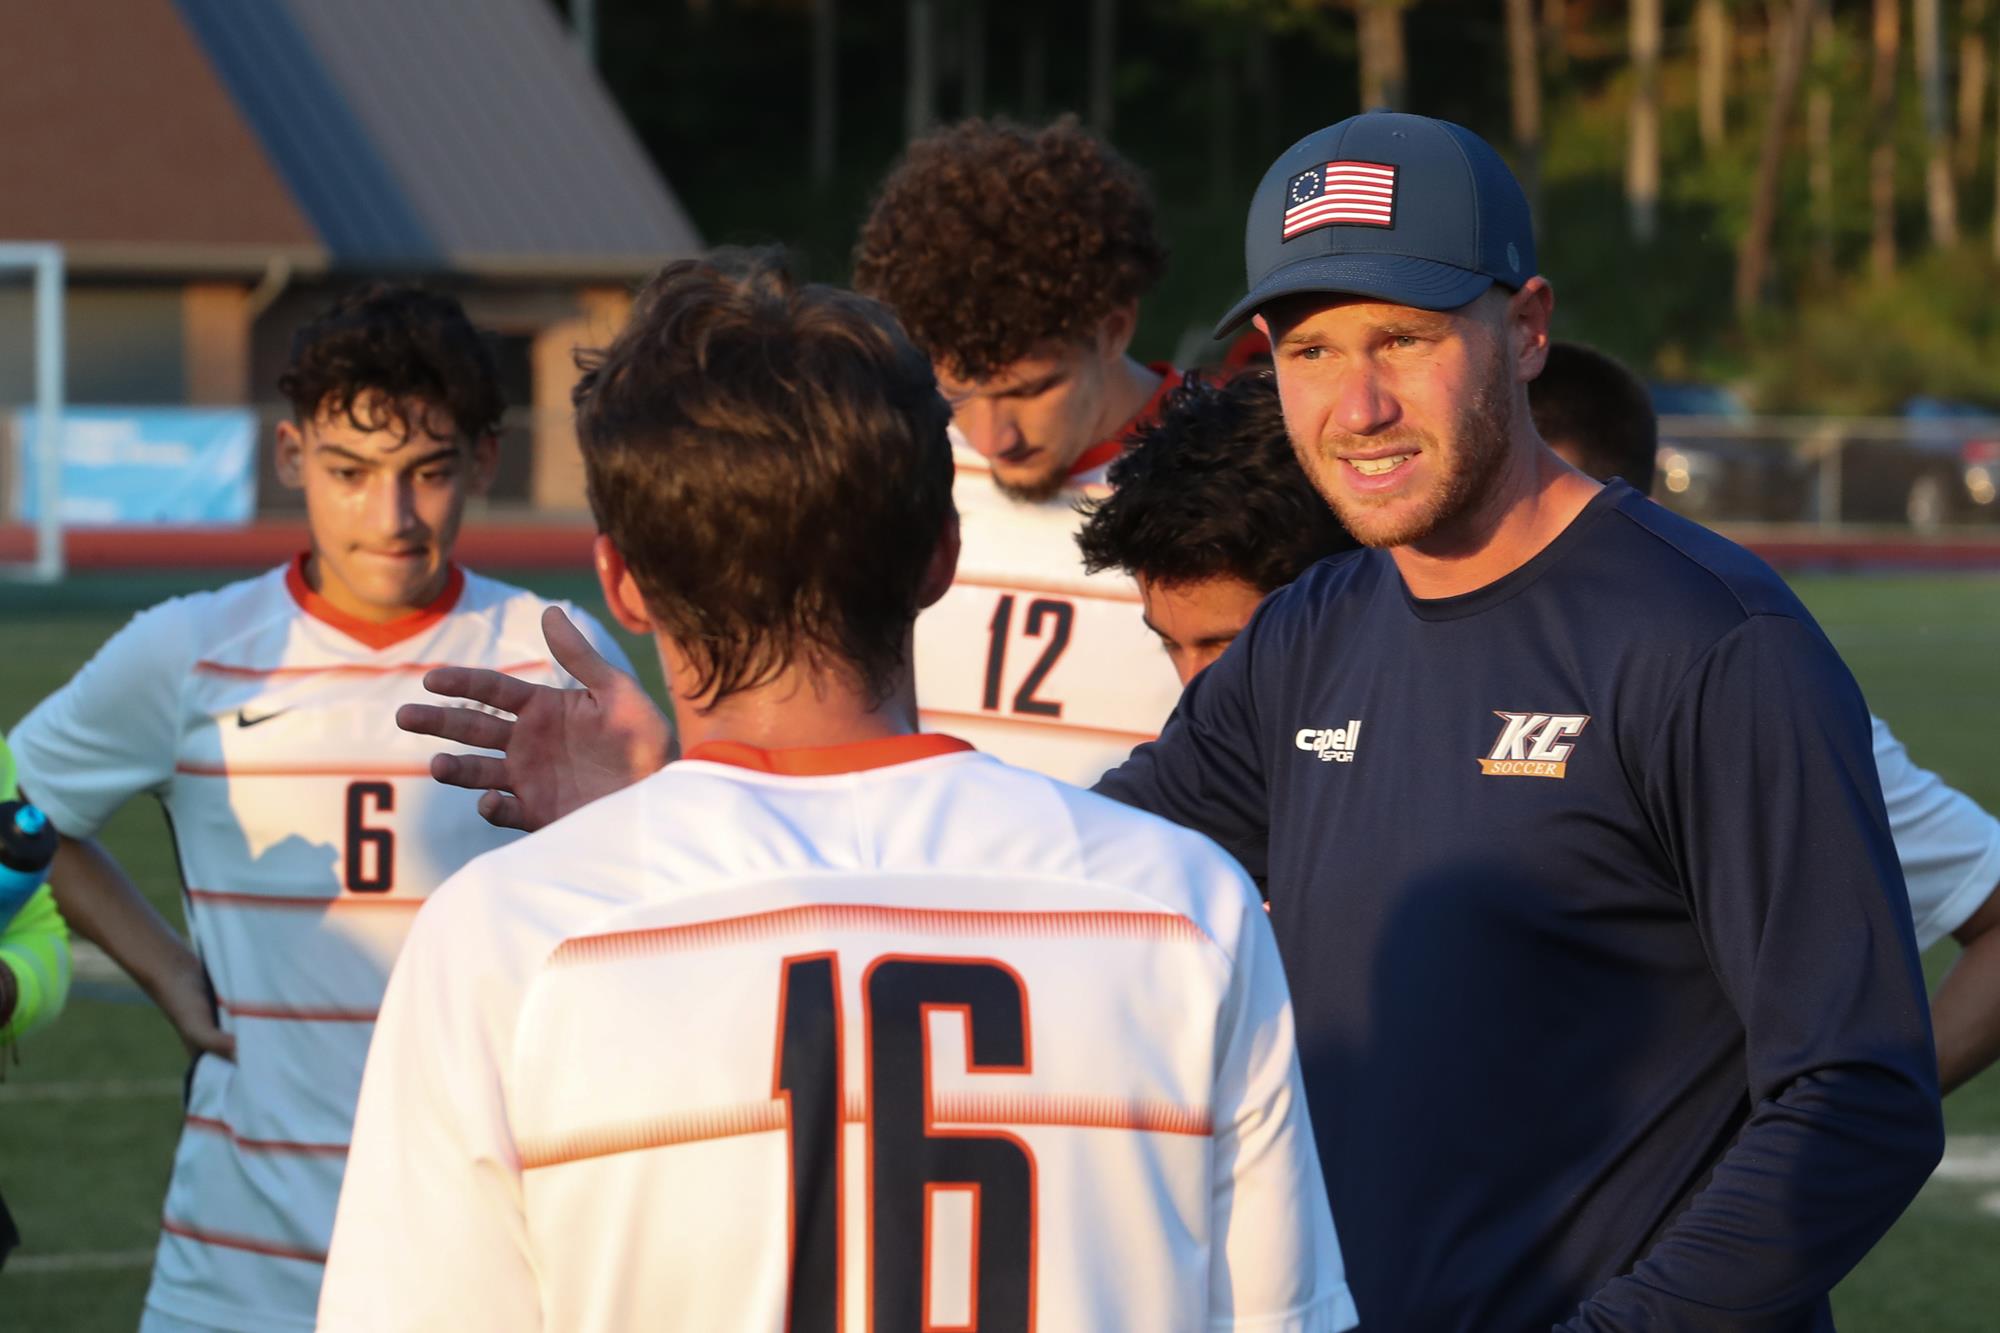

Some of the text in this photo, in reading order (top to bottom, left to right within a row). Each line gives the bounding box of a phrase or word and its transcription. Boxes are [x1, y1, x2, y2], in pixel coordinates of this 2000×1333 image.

[982, 593, 1075, 718] 12
[1488, 710, 1591, 762] KC
[1490, 761, 1558, 775] SOCCER
[345, 780, 396, 894] 6
[771, 950, 1038, 1333] 16
